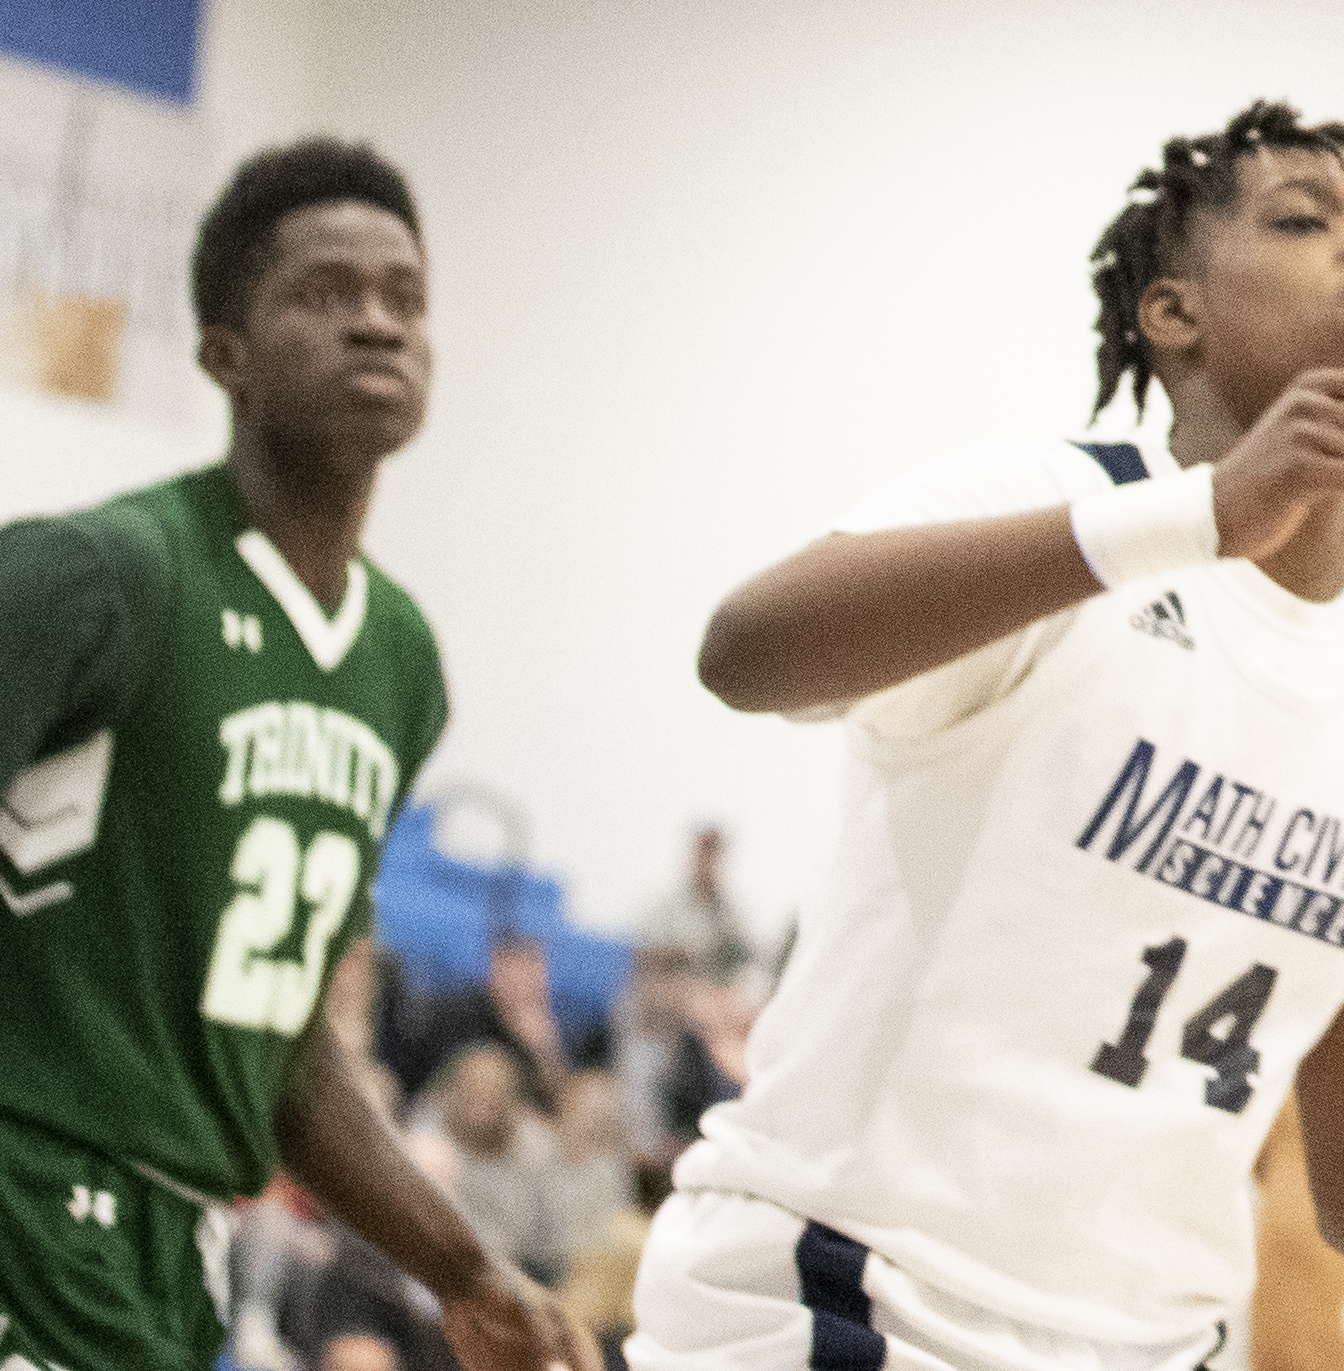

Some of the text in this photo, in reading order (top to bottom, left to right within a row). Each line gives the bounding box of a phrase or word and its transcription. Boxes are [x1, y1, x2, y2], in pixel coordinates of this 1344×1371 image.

[219, 701, 400, 841] TRINITY
[1075, 736, 1278, 875] MATH
[1090, 933, 1280, 1115] 14
